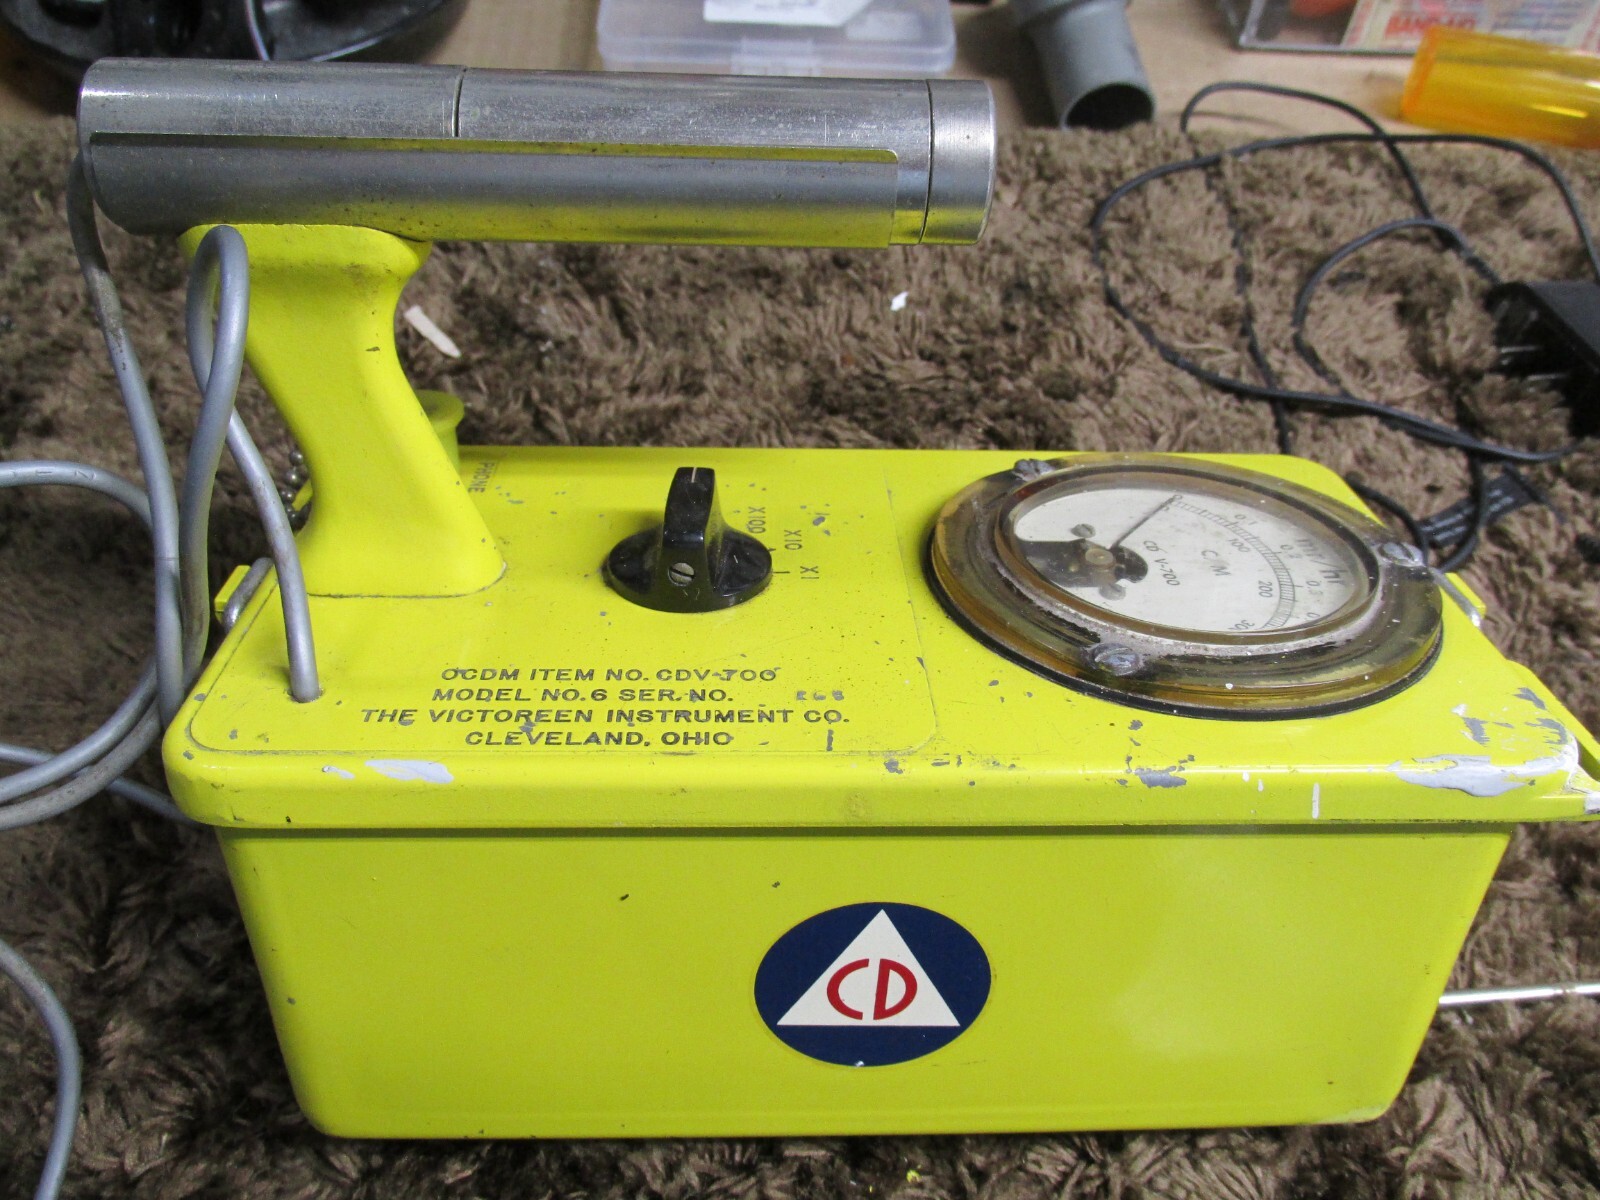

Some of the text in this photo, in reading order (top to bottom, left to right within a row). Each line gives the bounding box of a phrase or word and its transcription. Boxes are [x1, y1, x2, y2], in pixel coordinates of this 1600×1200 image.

[467, 462, 496, 494] PHONE
[747, 506, 767, 534] X100
[784, 529, 804, 551] X10
[1228, 537, 1250, 553] 100
[1154, 557, 1181, 587] V-700
[1258, 579, 1273, 598] 200
[441, 666, 778, 682] OCDM ITEM NO. CDV-700
[431, 687, 532, 703] MODEL
[618, 687, 683, 702] SER.
[688, 687, 734, 703] NO.
[361, 707, 850, 725] THE VICTOREEN INSTRUMENT CO.
[465, 730, 734, 747] CLEVELAND, OHIO
[826, 957, 918, 1021] CD
